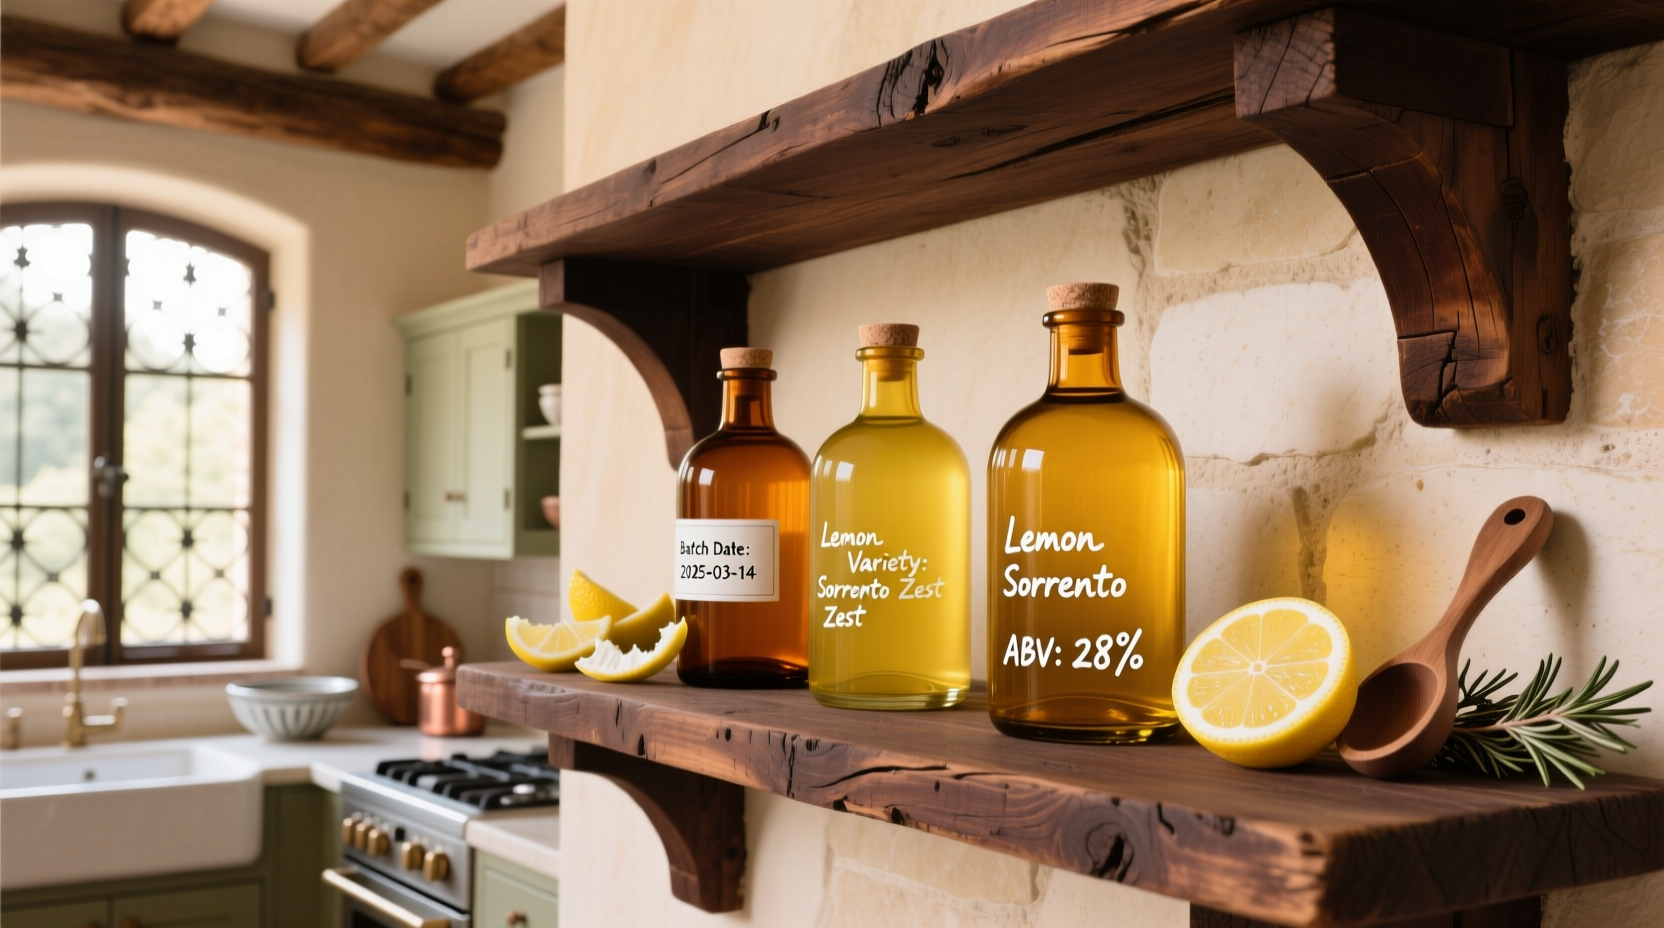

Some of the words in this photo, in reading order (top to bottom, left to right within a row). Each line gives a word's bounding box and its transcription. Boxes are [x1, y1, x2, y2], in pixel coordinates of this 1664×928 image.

[680, 540, 709, 555] Batch
[713, 541, 750, 556] Date:
[820, 520, 884, 548] Lemon
[1004, 515, 1105, 555] Lemon
[680, 564, 757, 580] 2025-03-14
[847, 549, 928, 578] Variety:
[898, 577, 945, 600] Zest
[1003, 563, 1127, 599] Sorrento
[823, 604, 867, 628] Zest
[1003, 633, 1062, 668] ABV:
[1071, 627, 1144, 678] 28%
